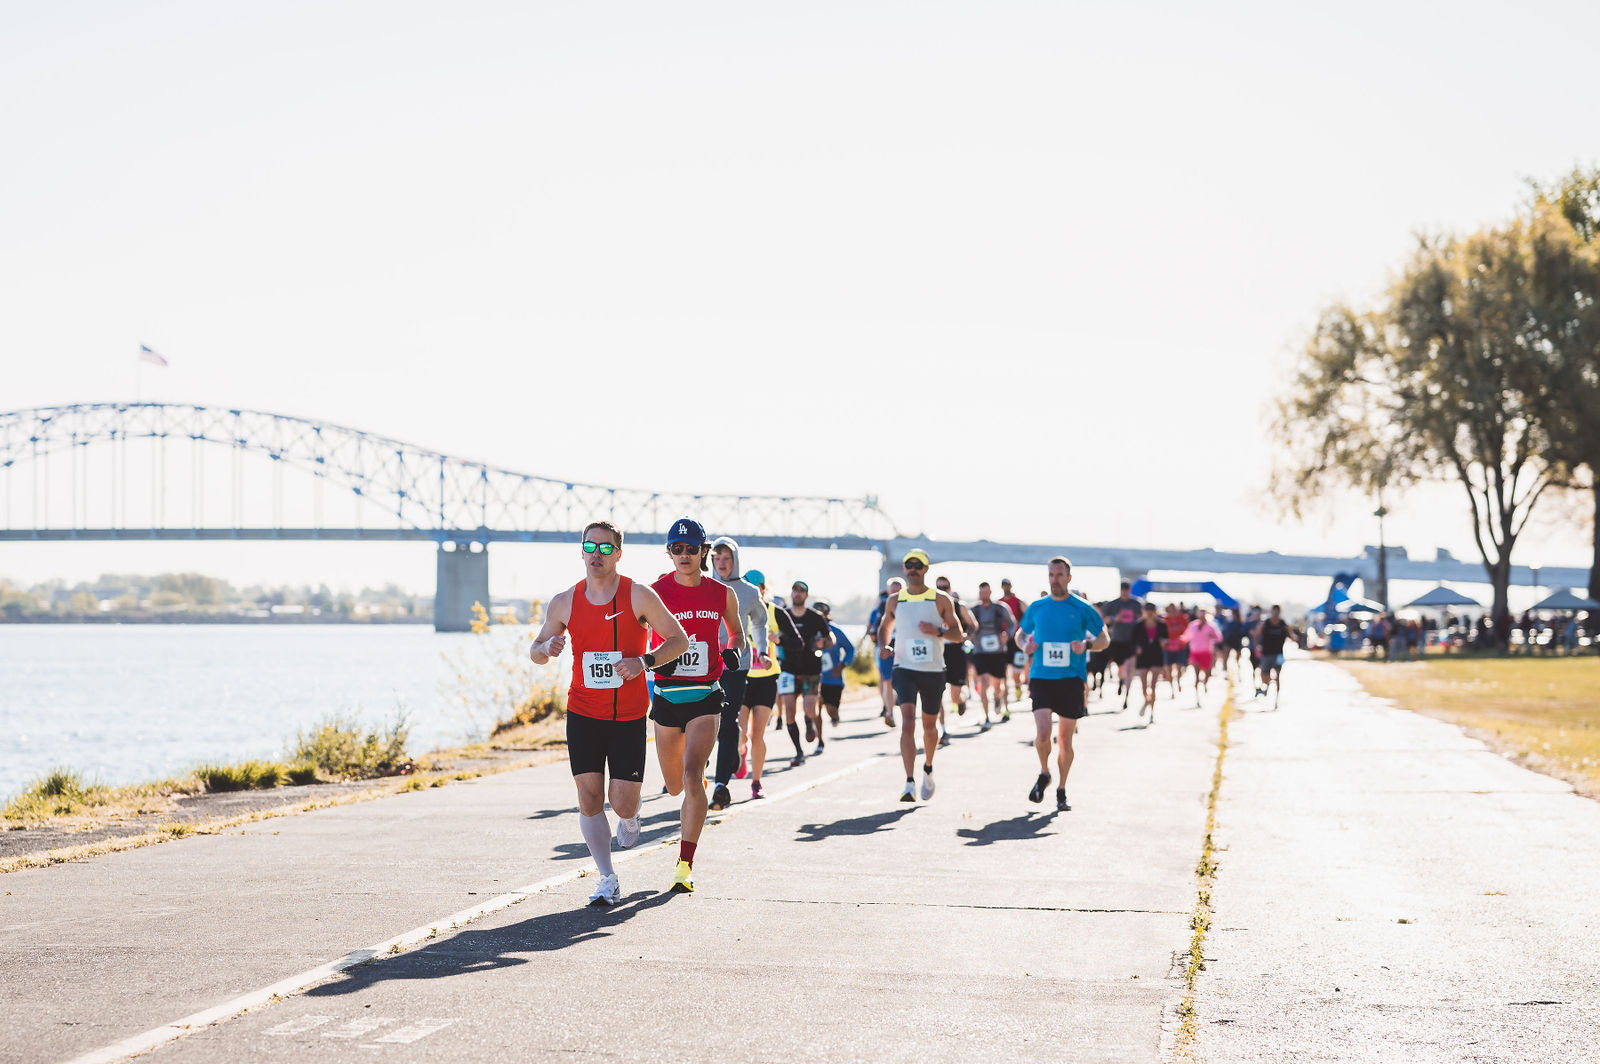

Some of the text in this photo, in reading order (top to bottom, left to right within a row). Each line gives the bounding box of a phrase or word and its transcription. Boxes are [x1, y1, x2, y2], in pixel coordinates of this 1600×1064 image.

[678, 522, 688, 535] LA
[674, 610, 719, 621] ONG KONG
[911, 645, 928, 656] 154
[1048, 650, 1064, 660] 144
[588, 663, 614, 678] 159
